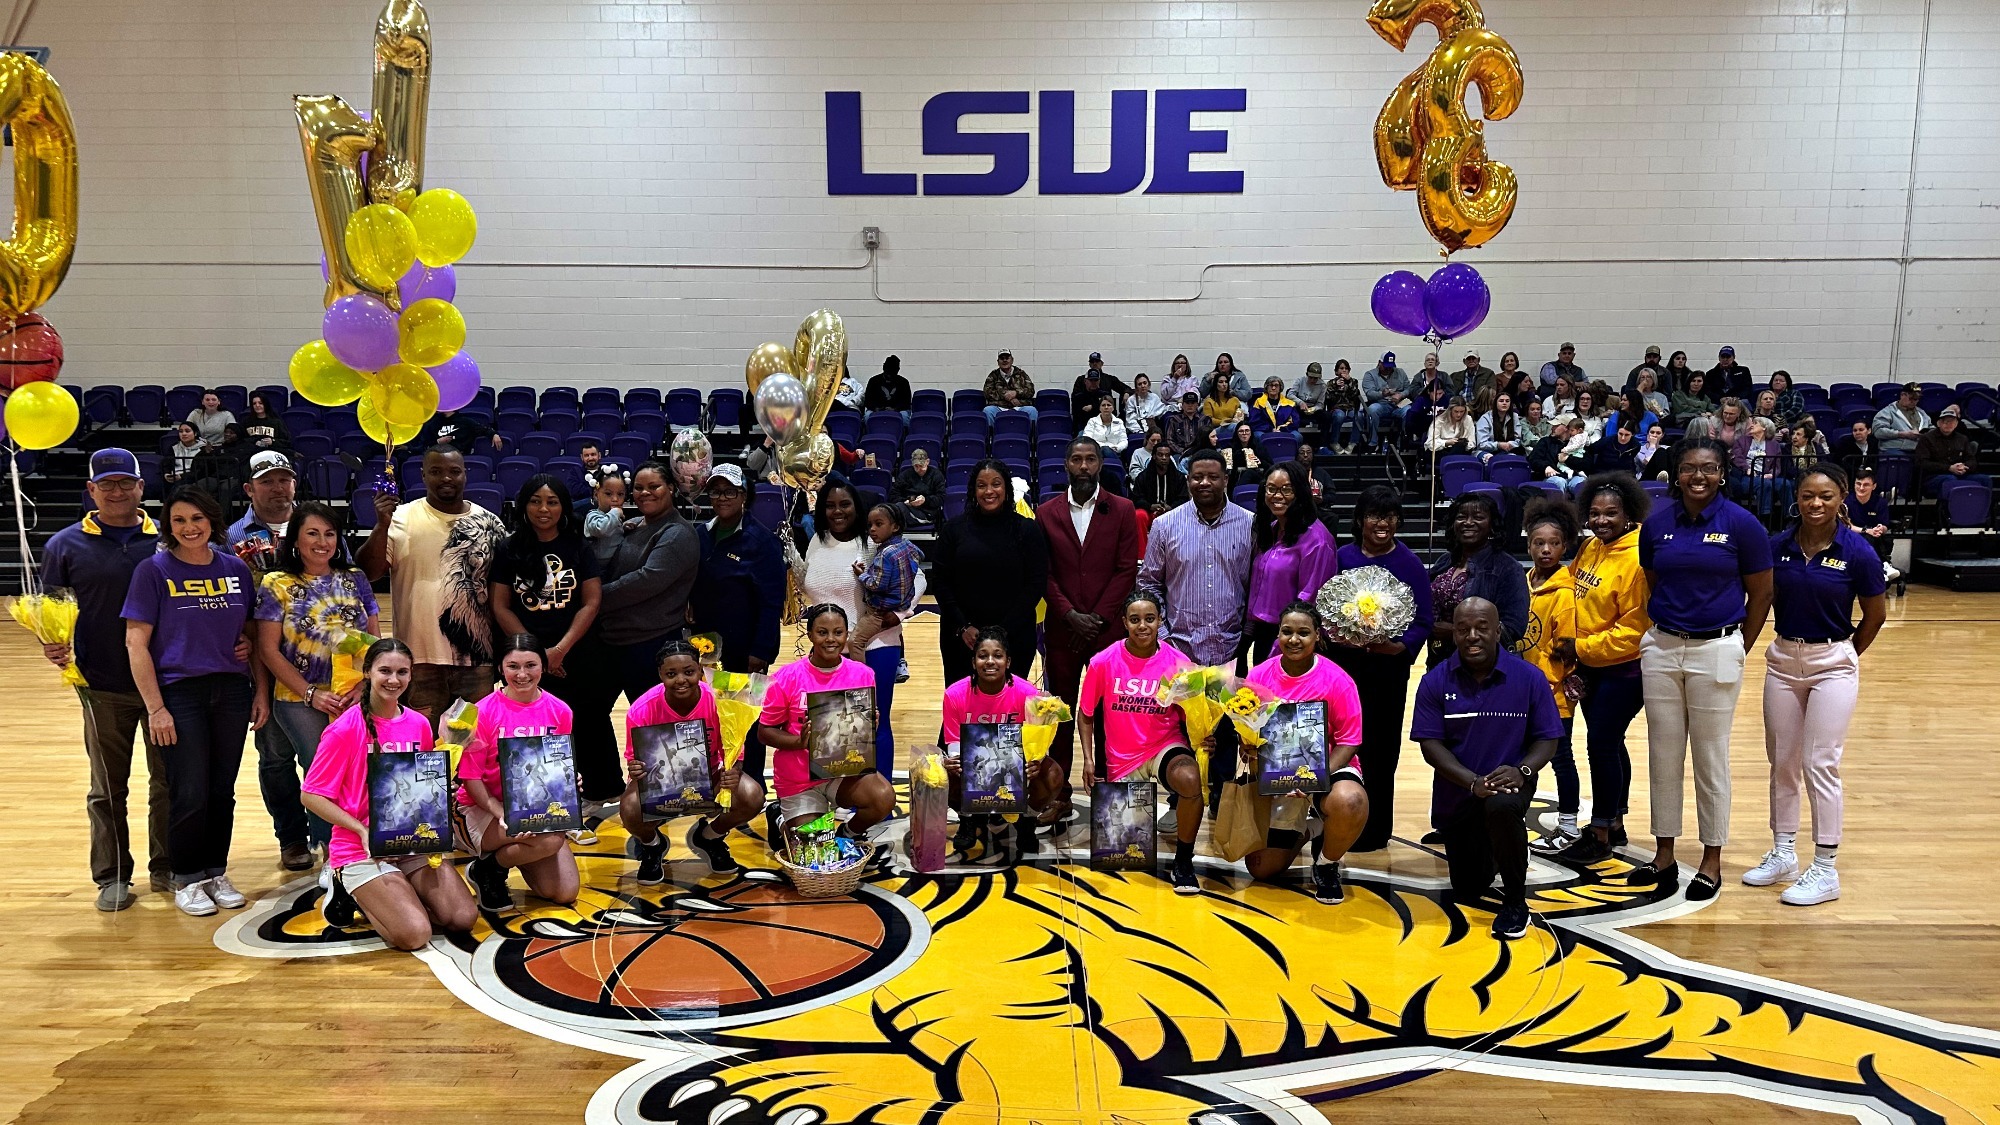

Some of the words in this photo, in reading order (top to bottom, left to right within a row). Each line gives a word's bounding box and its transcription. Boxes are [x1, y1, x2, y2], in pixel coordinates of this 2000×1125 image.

[825, 89, 1247, 195] LSUE
[1703, 533, 1729, 542] LSUE
[1821, 556, 1848, 569] LSUE
[166, 577, 241, 597] LSUE
[199, 602, 229, 610] MOM
[1113, 677, 1161, 697] LSU
[1270, 779, 1318, 789] BENGALS
[971, 799, 1016, 808] BENGALS
[520, 816, 572, 828] BENGALS
[385, 839, 441, 851] BENGALS
